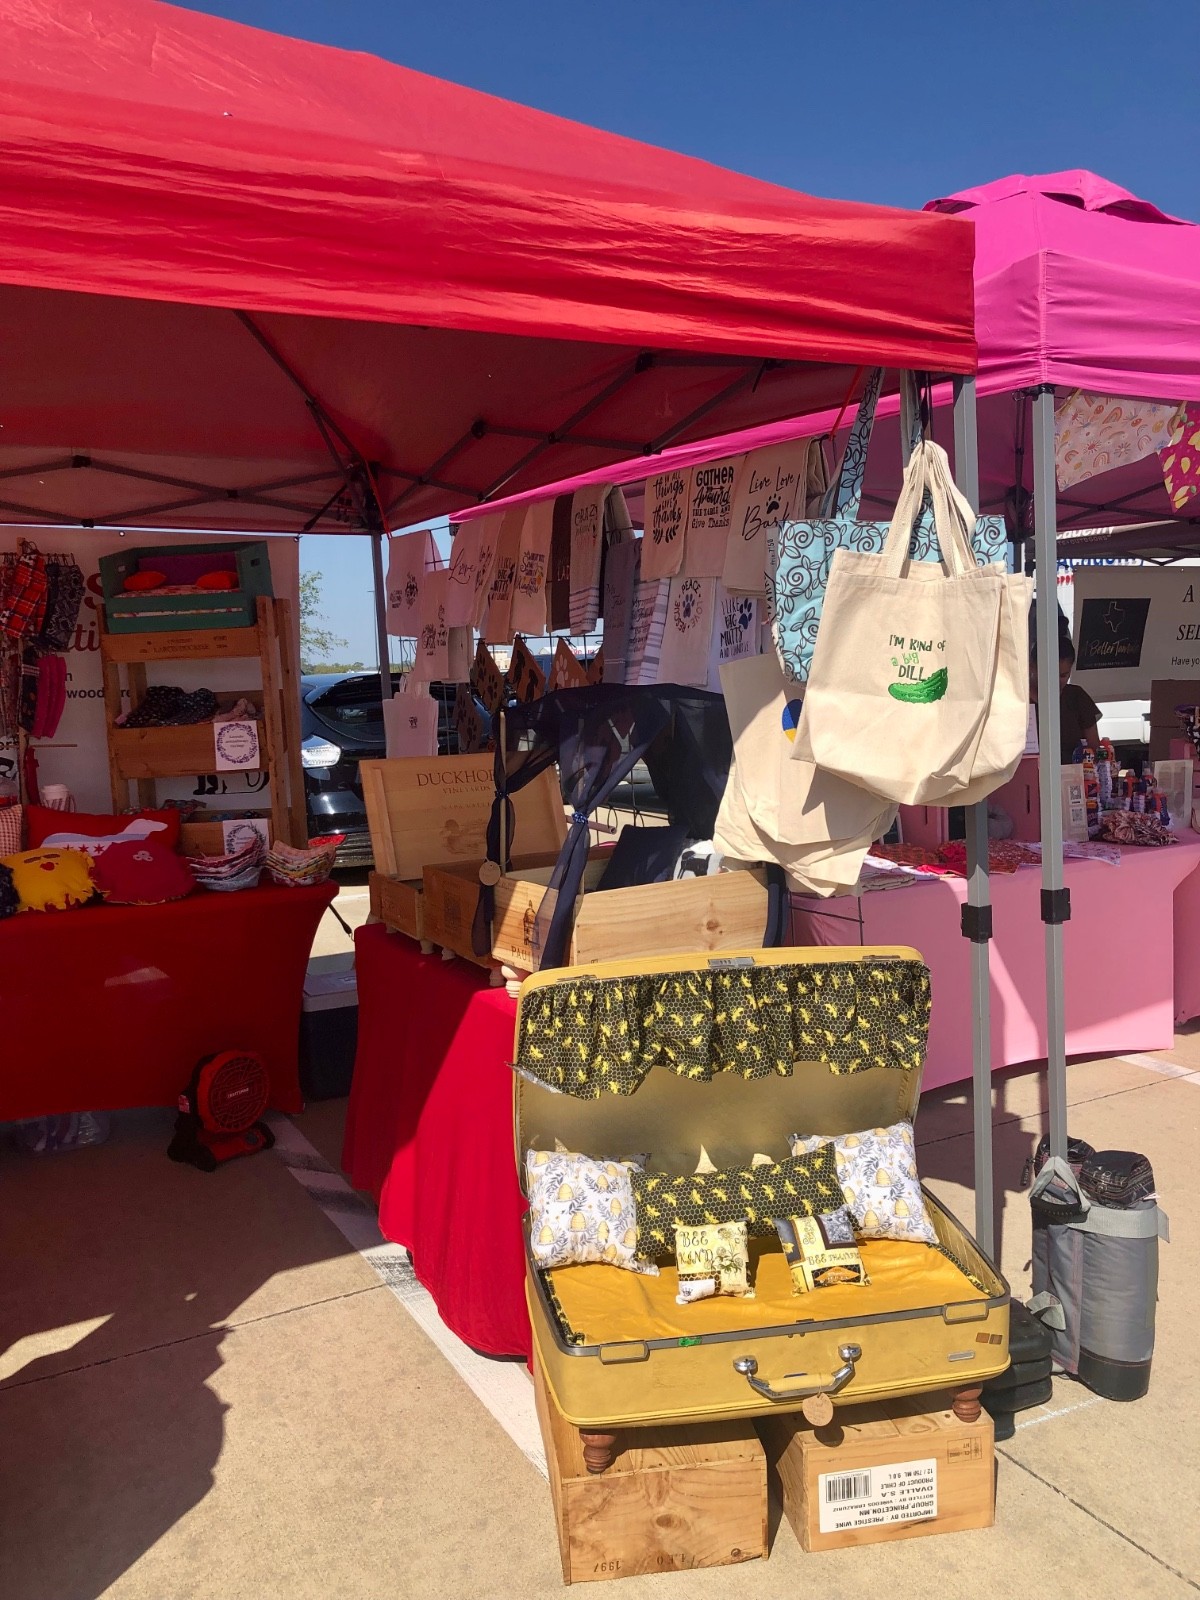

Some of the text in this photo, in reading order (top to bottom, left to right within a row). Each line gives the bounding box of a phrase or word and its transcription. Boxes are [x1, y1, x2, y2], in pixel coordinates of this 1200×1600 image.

[653, 478, 685, 500] things
[653, 499, 682, 528] thanks
[889, 634, 905, 650] I'M
[891, 652, 920, 666] a big
[1171, 656, 1190, 665] Have
[898, 664, 927, 682] DILL
[680, 1230, 709, 1248] BEE
[806, 1253, 827, 1266] BEE
[881, 1482, 897, 1490] CHILE
[908, 1477, 934, 1486] PRODUCT
[899, 1485, 934, 1496] OVALLE
[900, 1508, 934, 1519] IMPORTED
[835, 1521, 853, 1529] WINE
[854, 1516, 885, 1526] PRESTIGE
